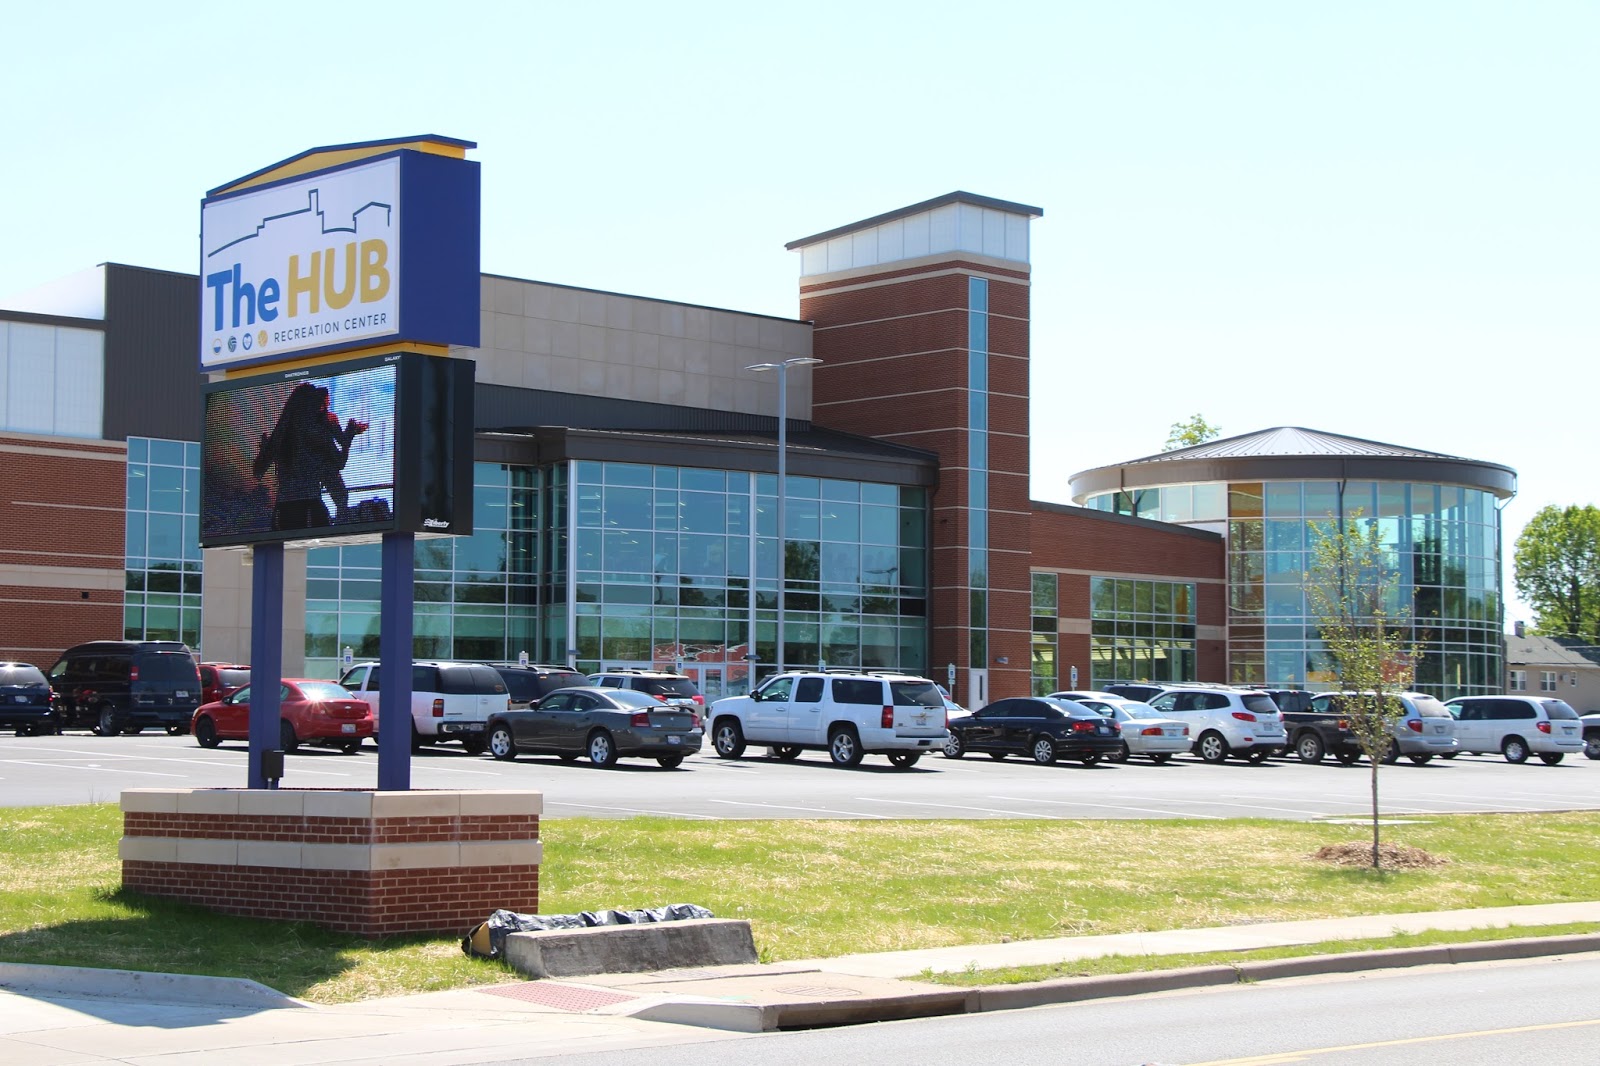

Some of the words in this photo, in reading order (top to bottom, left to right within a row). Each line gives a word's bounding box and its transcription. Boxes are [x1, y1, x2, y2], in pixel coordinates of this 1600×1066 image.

[207, 263, 280, 331] The
[287, 238, 391, 318] HUB
[274, 321, 340, 343] RECREATION
[344, 313, 387, 331] CENTER
